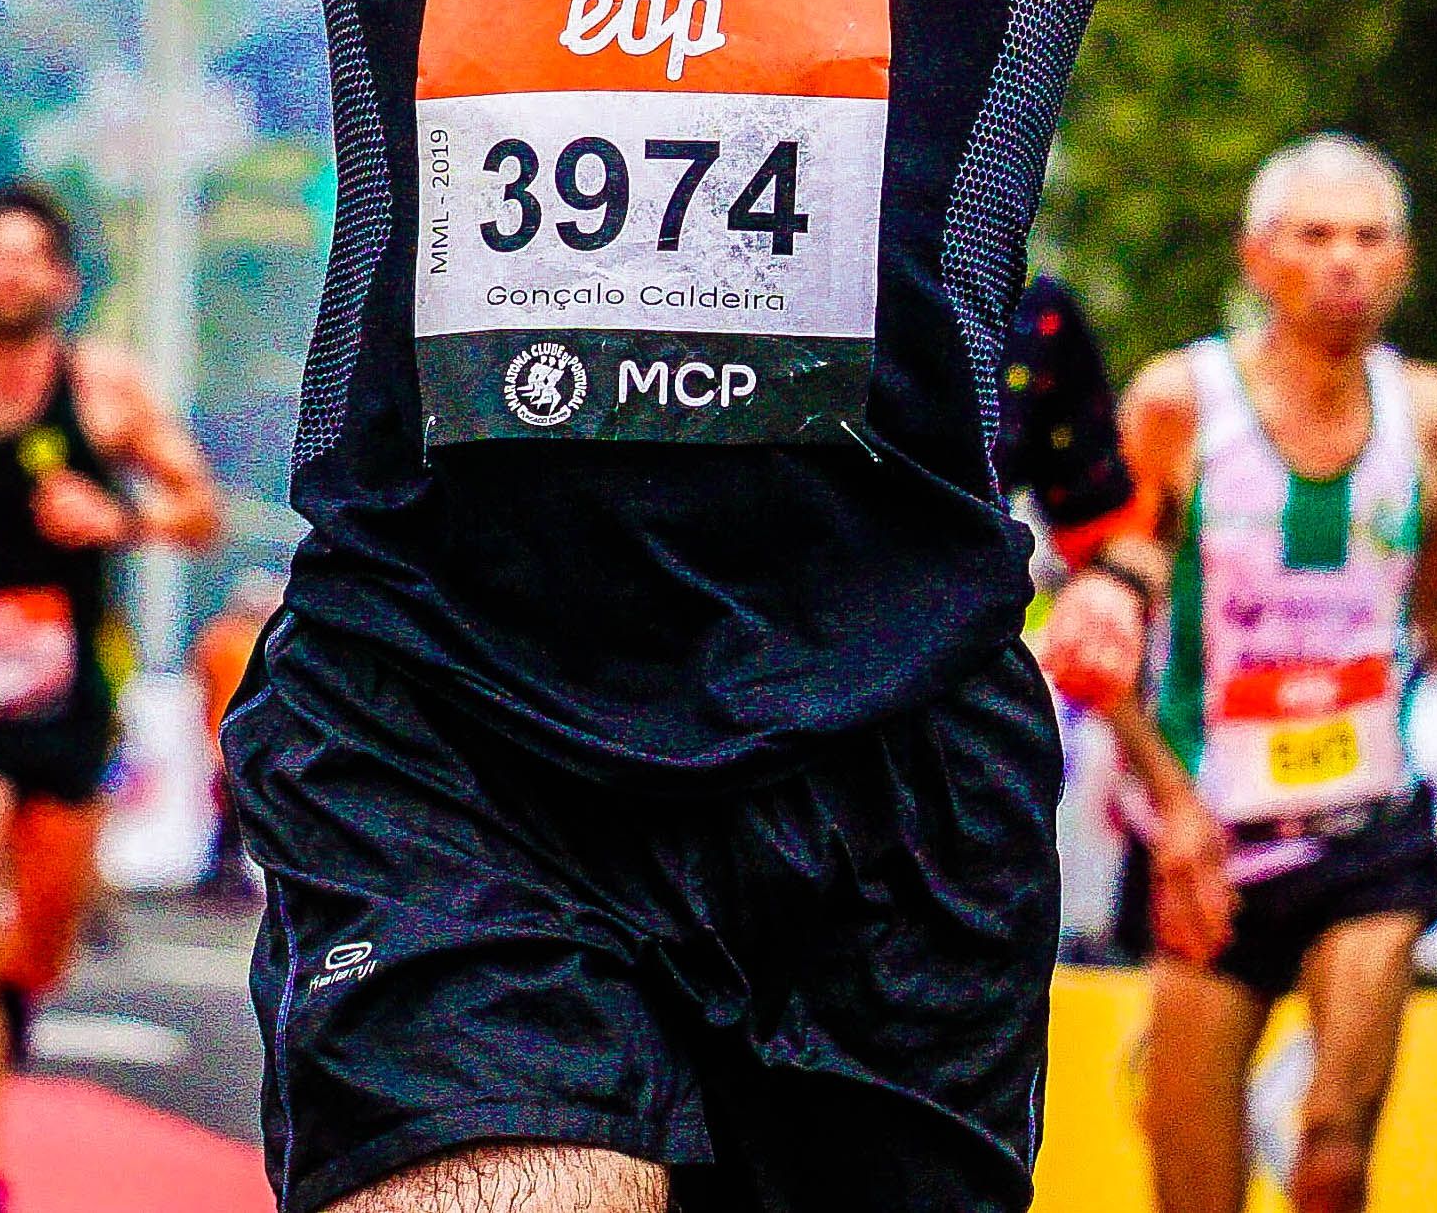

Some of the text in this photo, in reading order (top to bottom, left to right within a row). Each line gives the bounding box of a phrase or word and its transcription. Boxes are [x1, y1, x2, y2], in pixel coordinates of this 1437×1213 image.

[430, 129, 450, 188] 2019
[479, 136, 810, 256] 3974
[430, 211, 449, 274] MML
[486, 283, 786, 312] Gonçalo Caldeira
[618, 358, 757, 408] MCP
